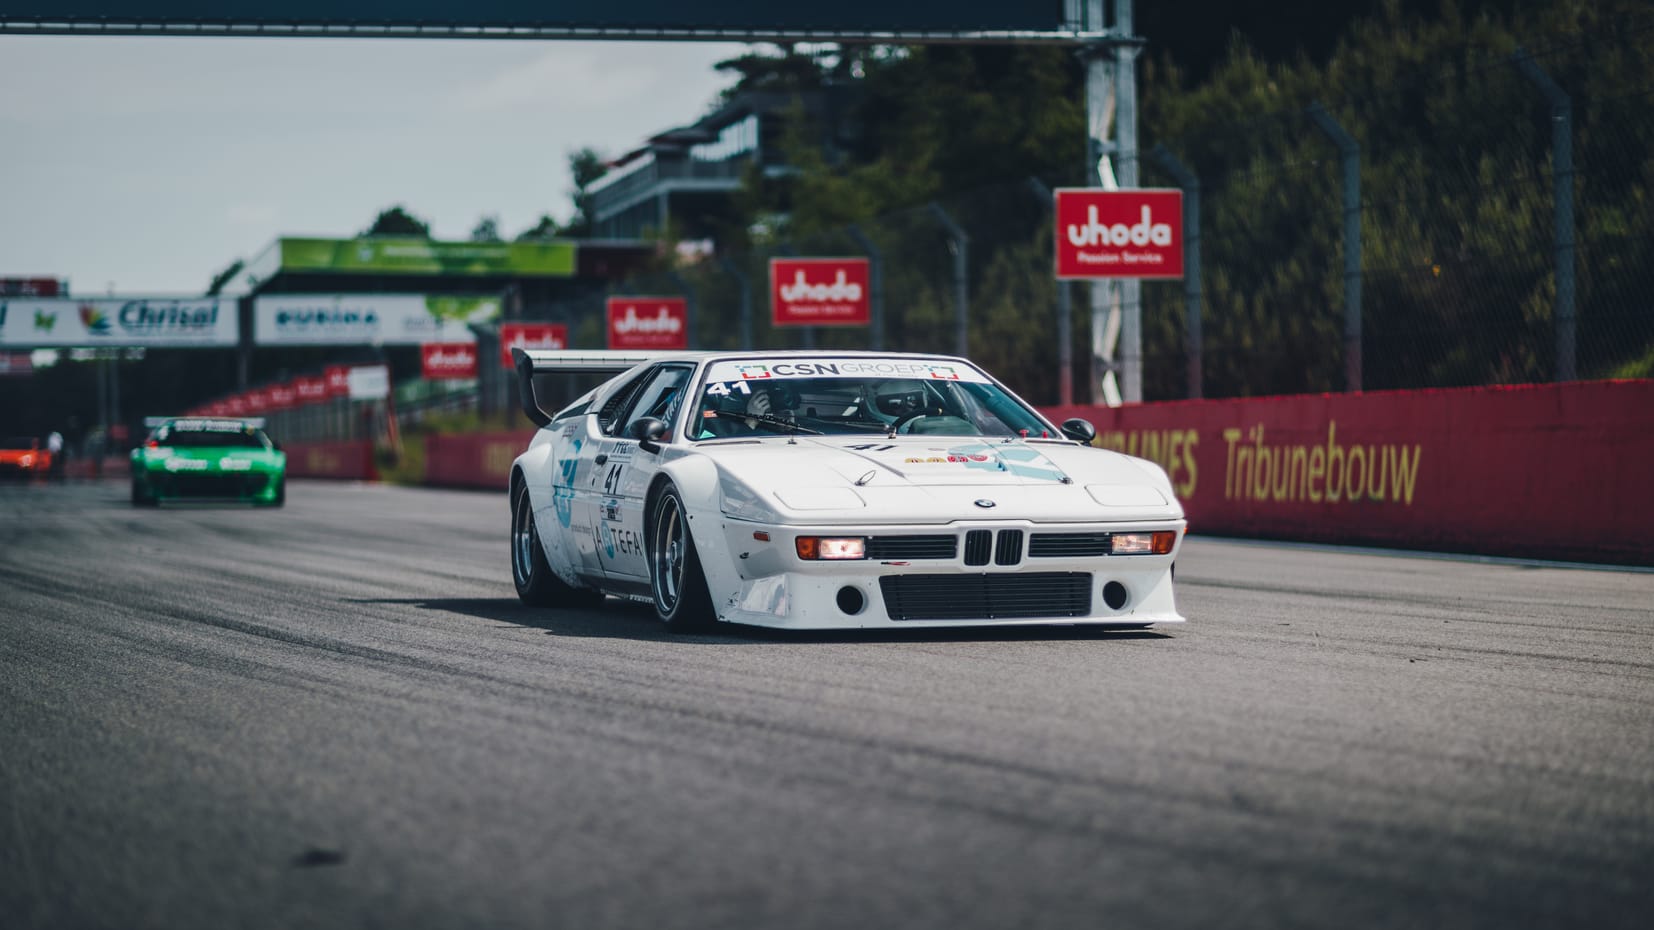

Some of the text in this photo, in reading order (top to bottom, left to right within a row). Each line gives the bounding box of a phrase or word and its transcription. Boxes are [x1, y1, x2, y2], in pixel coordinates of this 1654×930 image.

[1067, 204, 1172, 247] uhoda
[780, 269, 862, 302] uhoda
[119, 300, 219, 328] Chrisal
[614, 306, 682, 334] uhoda
[772, 363, 924, 376] CSN GROEP
[706, 381, 752, 396] 41
[1223, 419, 1421, 505] Tribunebouw
[604, 463, 624, 496] 41
